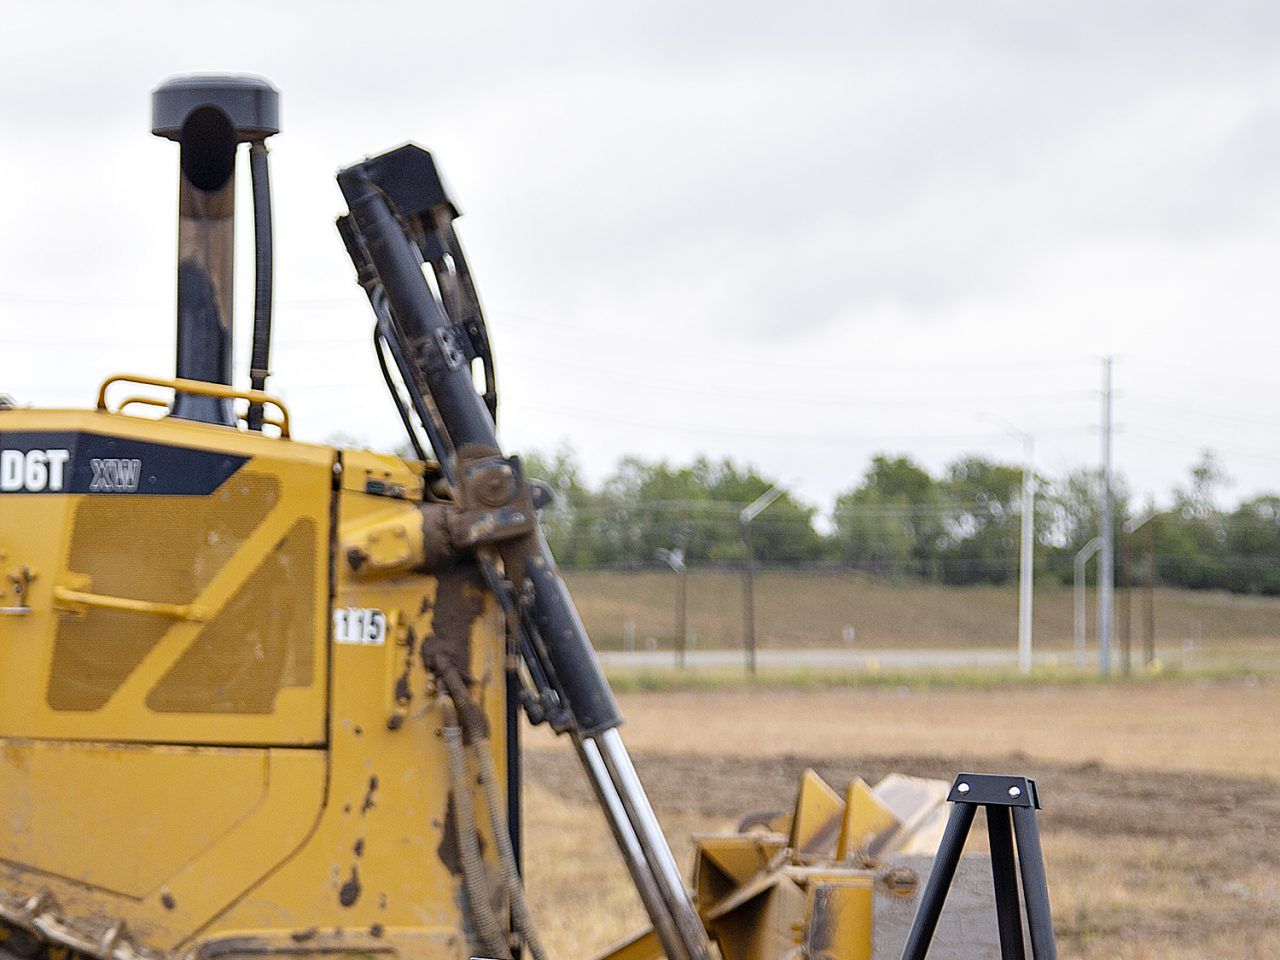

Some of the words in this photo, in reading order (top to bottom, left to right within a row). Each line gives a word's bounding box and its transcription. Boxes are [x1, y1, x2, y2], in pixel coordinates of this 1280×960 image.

[0, 449, 70, 492] D6T
[89, 458, 142, 492] XW
[339, 609, 384, 643] 115
